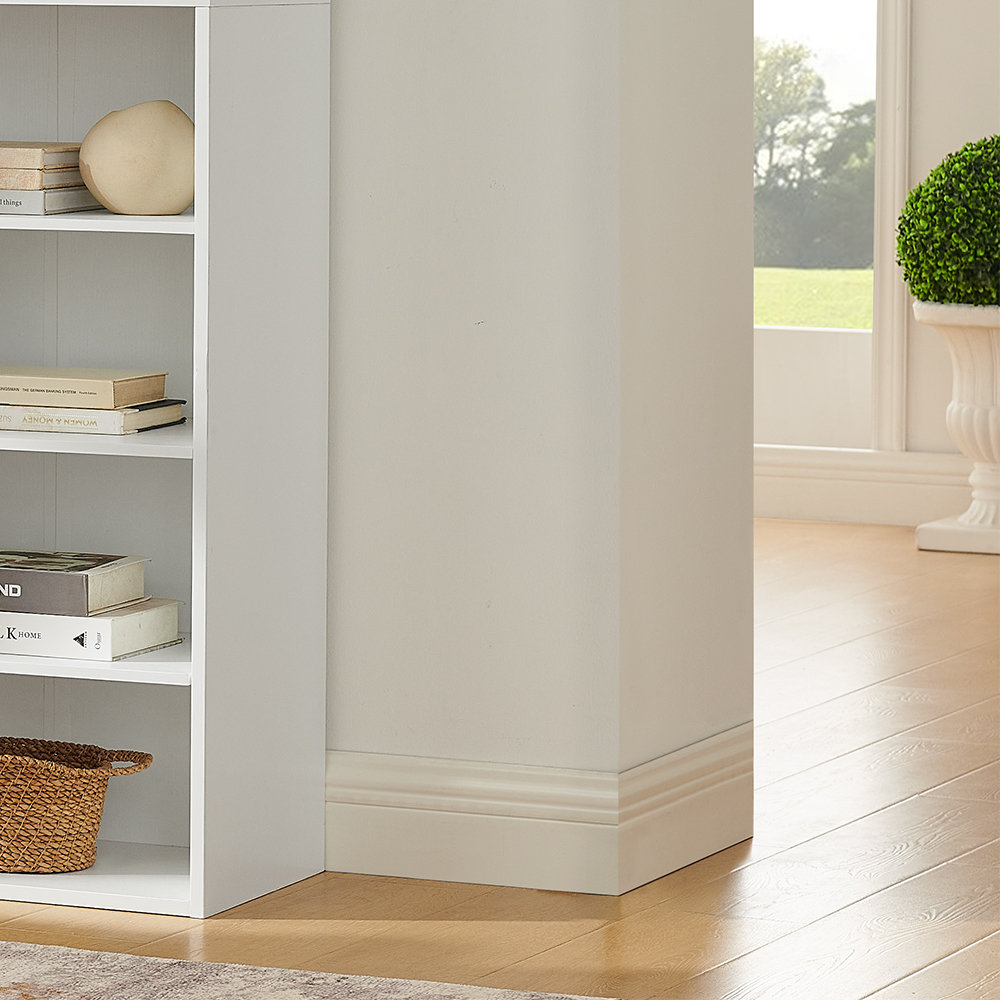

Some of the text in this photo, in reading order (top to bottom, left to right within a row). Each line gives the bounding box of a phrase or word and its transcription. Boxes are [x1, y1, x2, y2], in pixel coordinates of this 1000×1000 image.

[3, 198, 22, 208] things
[22, 415, 54, 424] MONEY
[63, 419, 98, 427] WOMEN
[18, 631, 42, 640] HOME
